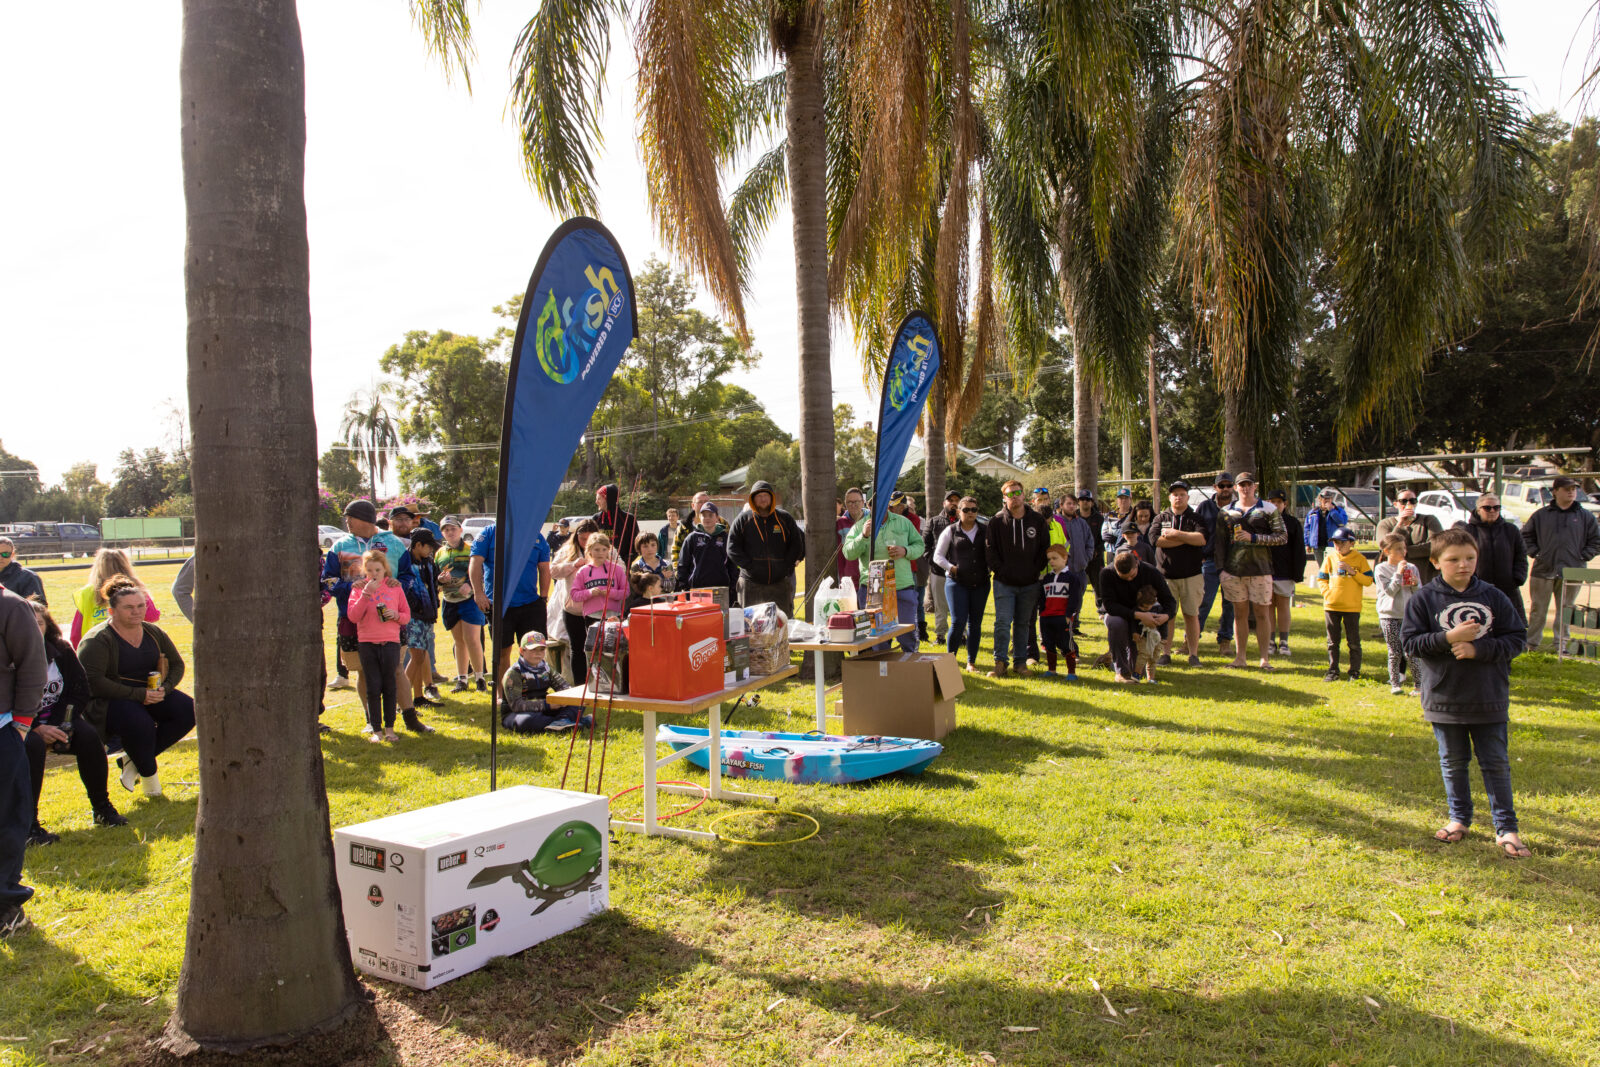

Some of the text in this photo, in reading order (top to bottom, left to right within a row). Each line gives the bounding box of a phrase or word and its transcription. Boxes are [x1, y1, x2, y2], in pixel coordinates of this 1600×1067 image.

[581, 330, 608, 380] POWERED
[604, 316, 614, 332] BY
[352, 845, 377, 866] weber
[440, 854, 460, 869] weber
